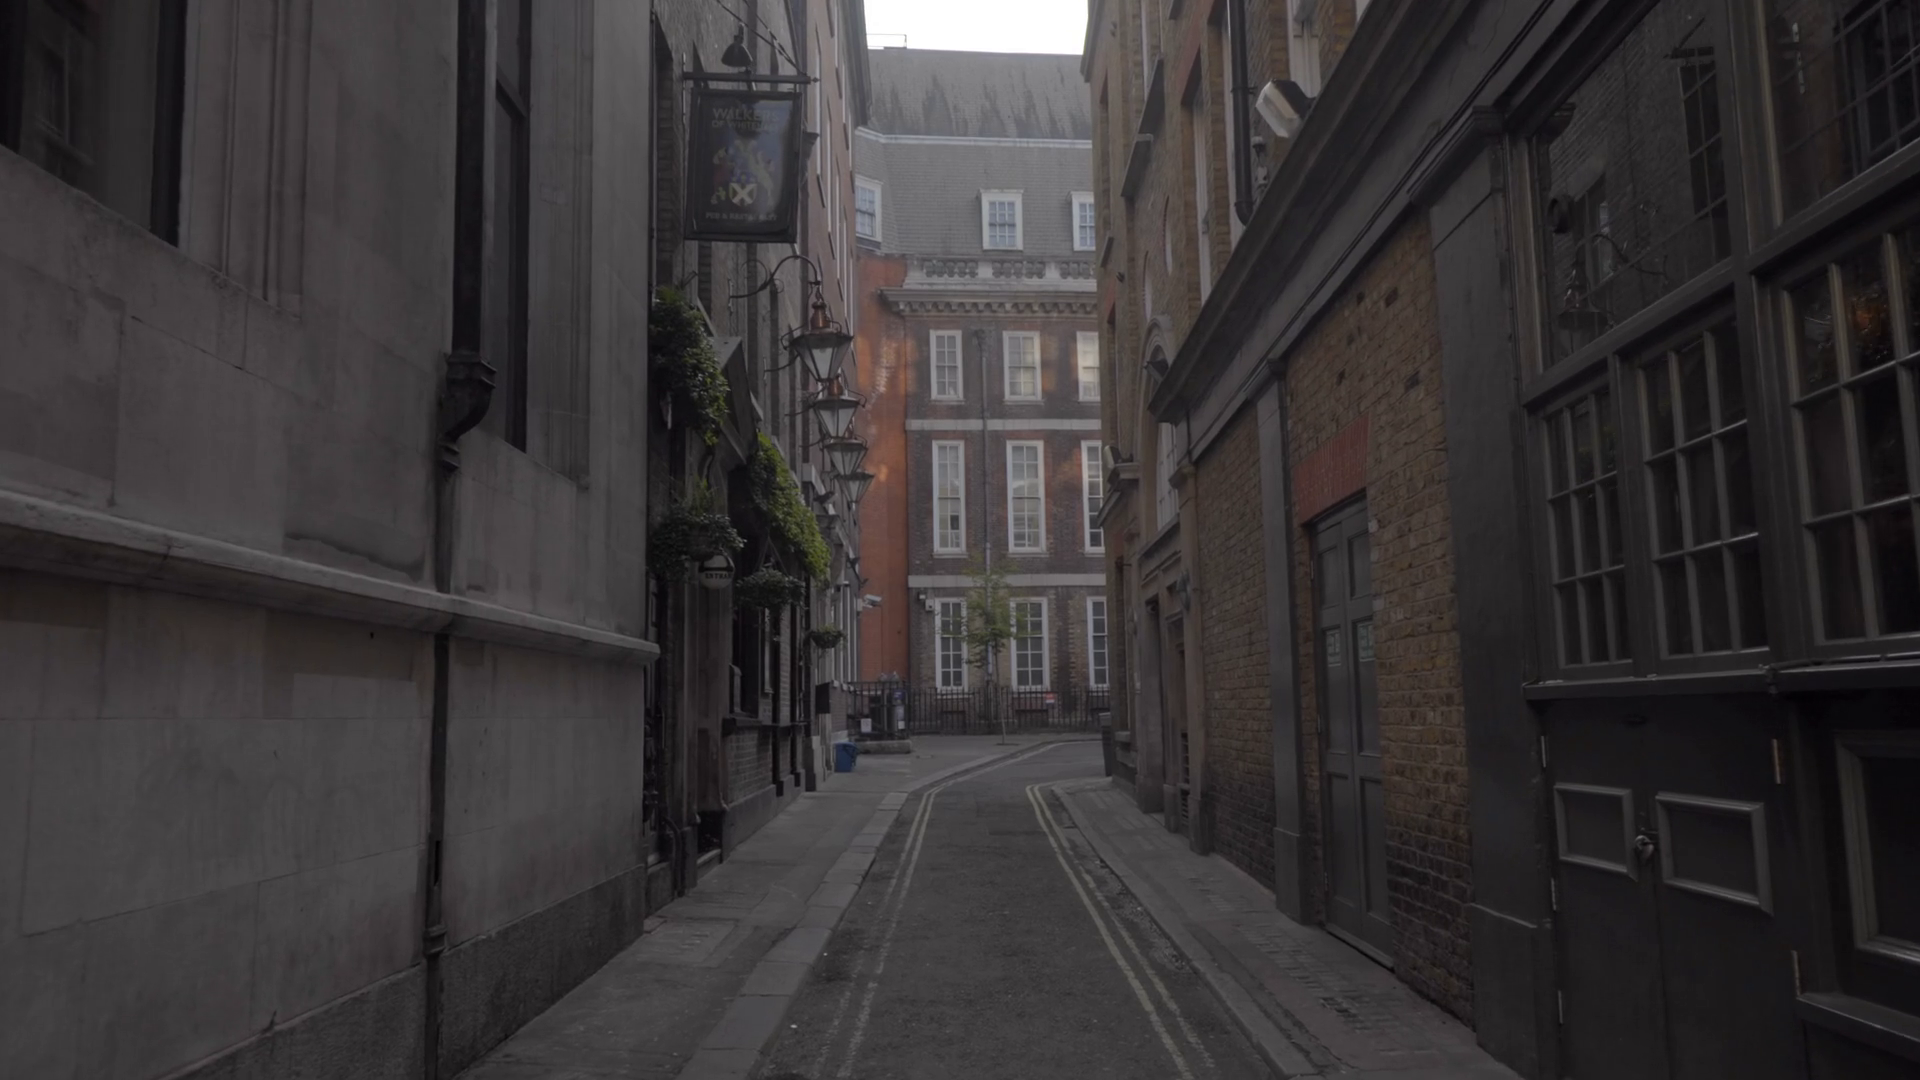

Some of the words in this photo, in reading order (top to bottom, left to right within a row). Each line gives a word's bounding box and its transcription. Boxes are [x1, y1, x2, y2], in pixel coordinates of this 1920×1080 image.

[713, 107, 779, 121] WALKERS
[712, 120, 724, 128] OF
[727, 120, 778, 133] WHITEHA
